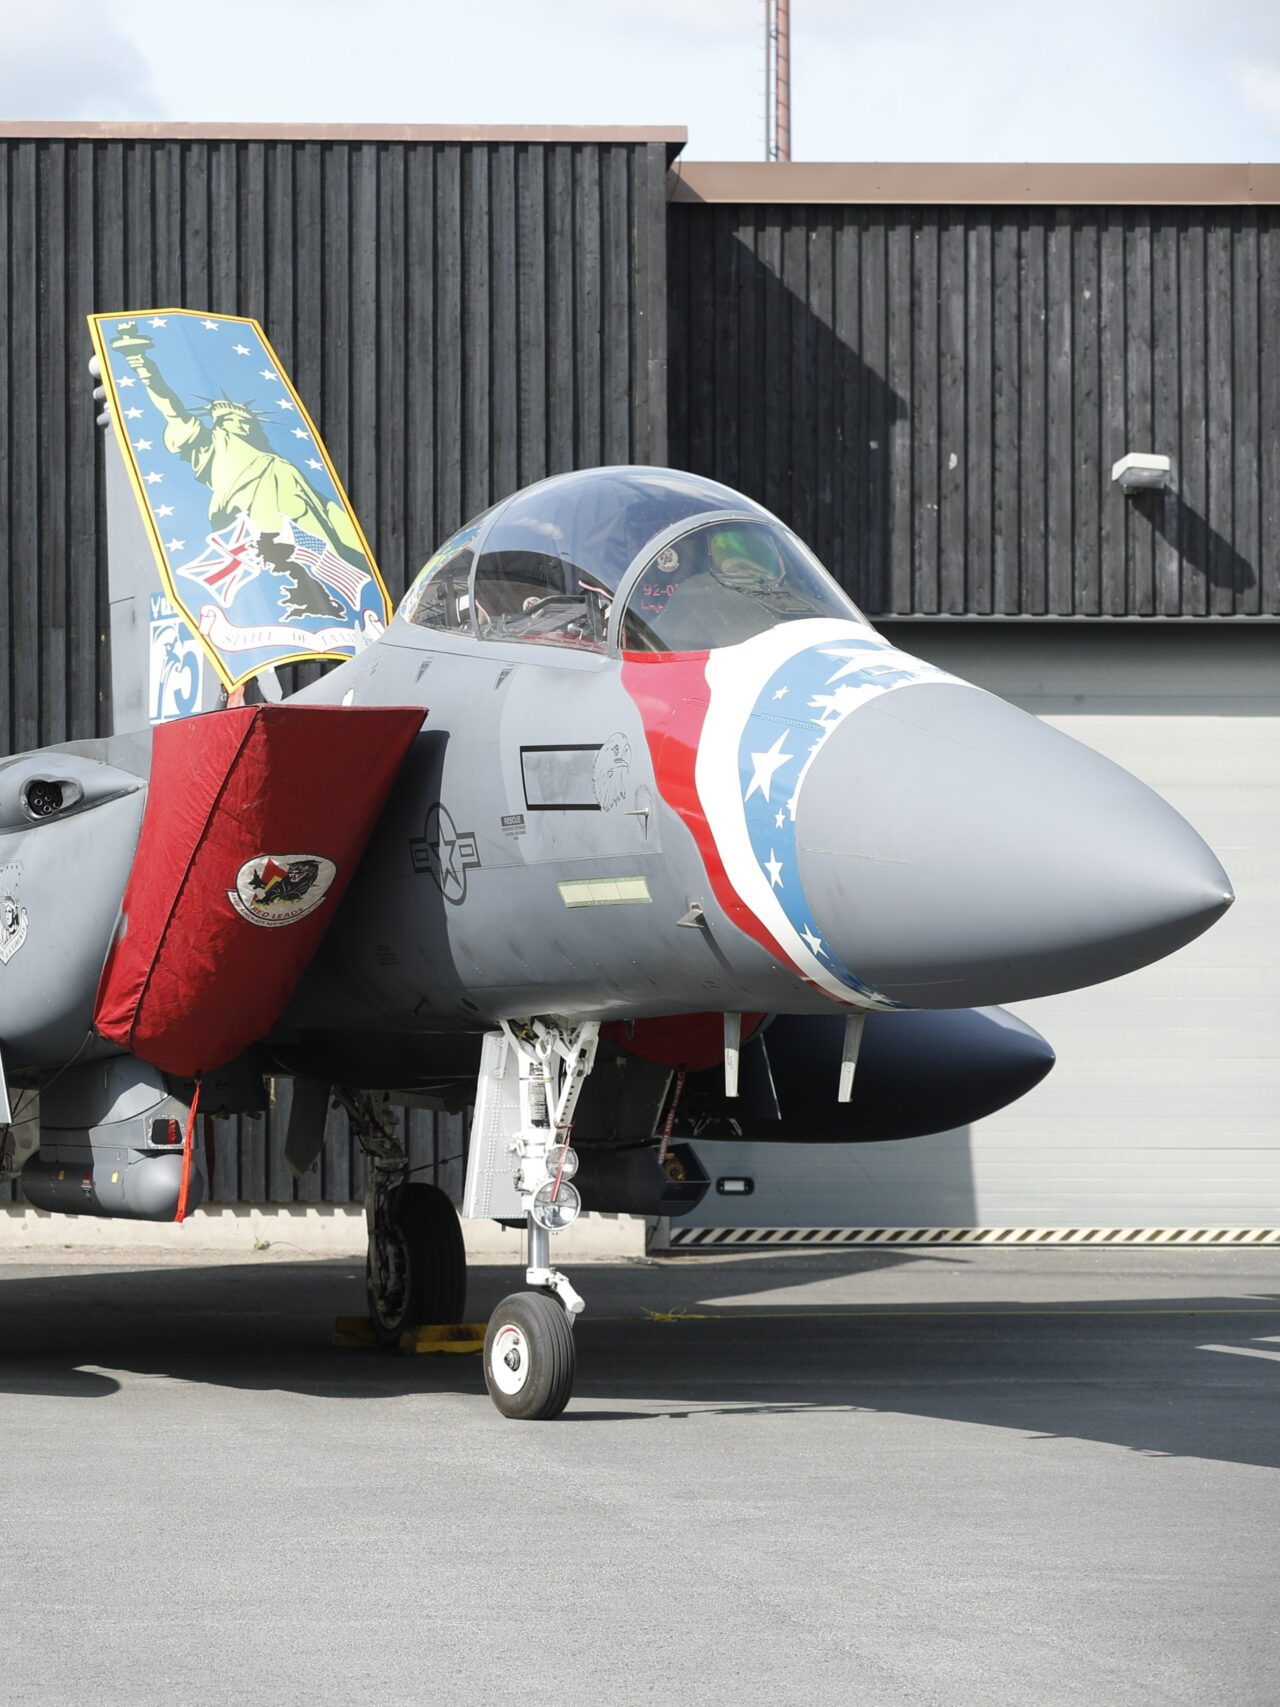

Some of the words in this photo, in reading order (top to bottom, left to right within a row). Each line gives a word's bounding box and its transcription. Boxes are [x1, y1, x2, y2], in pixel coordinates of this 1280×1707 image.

[643, 584, 679, 597] 92-0
[251, 906, 270, 919] RED
[271, 907, 305, 920] LEADS
